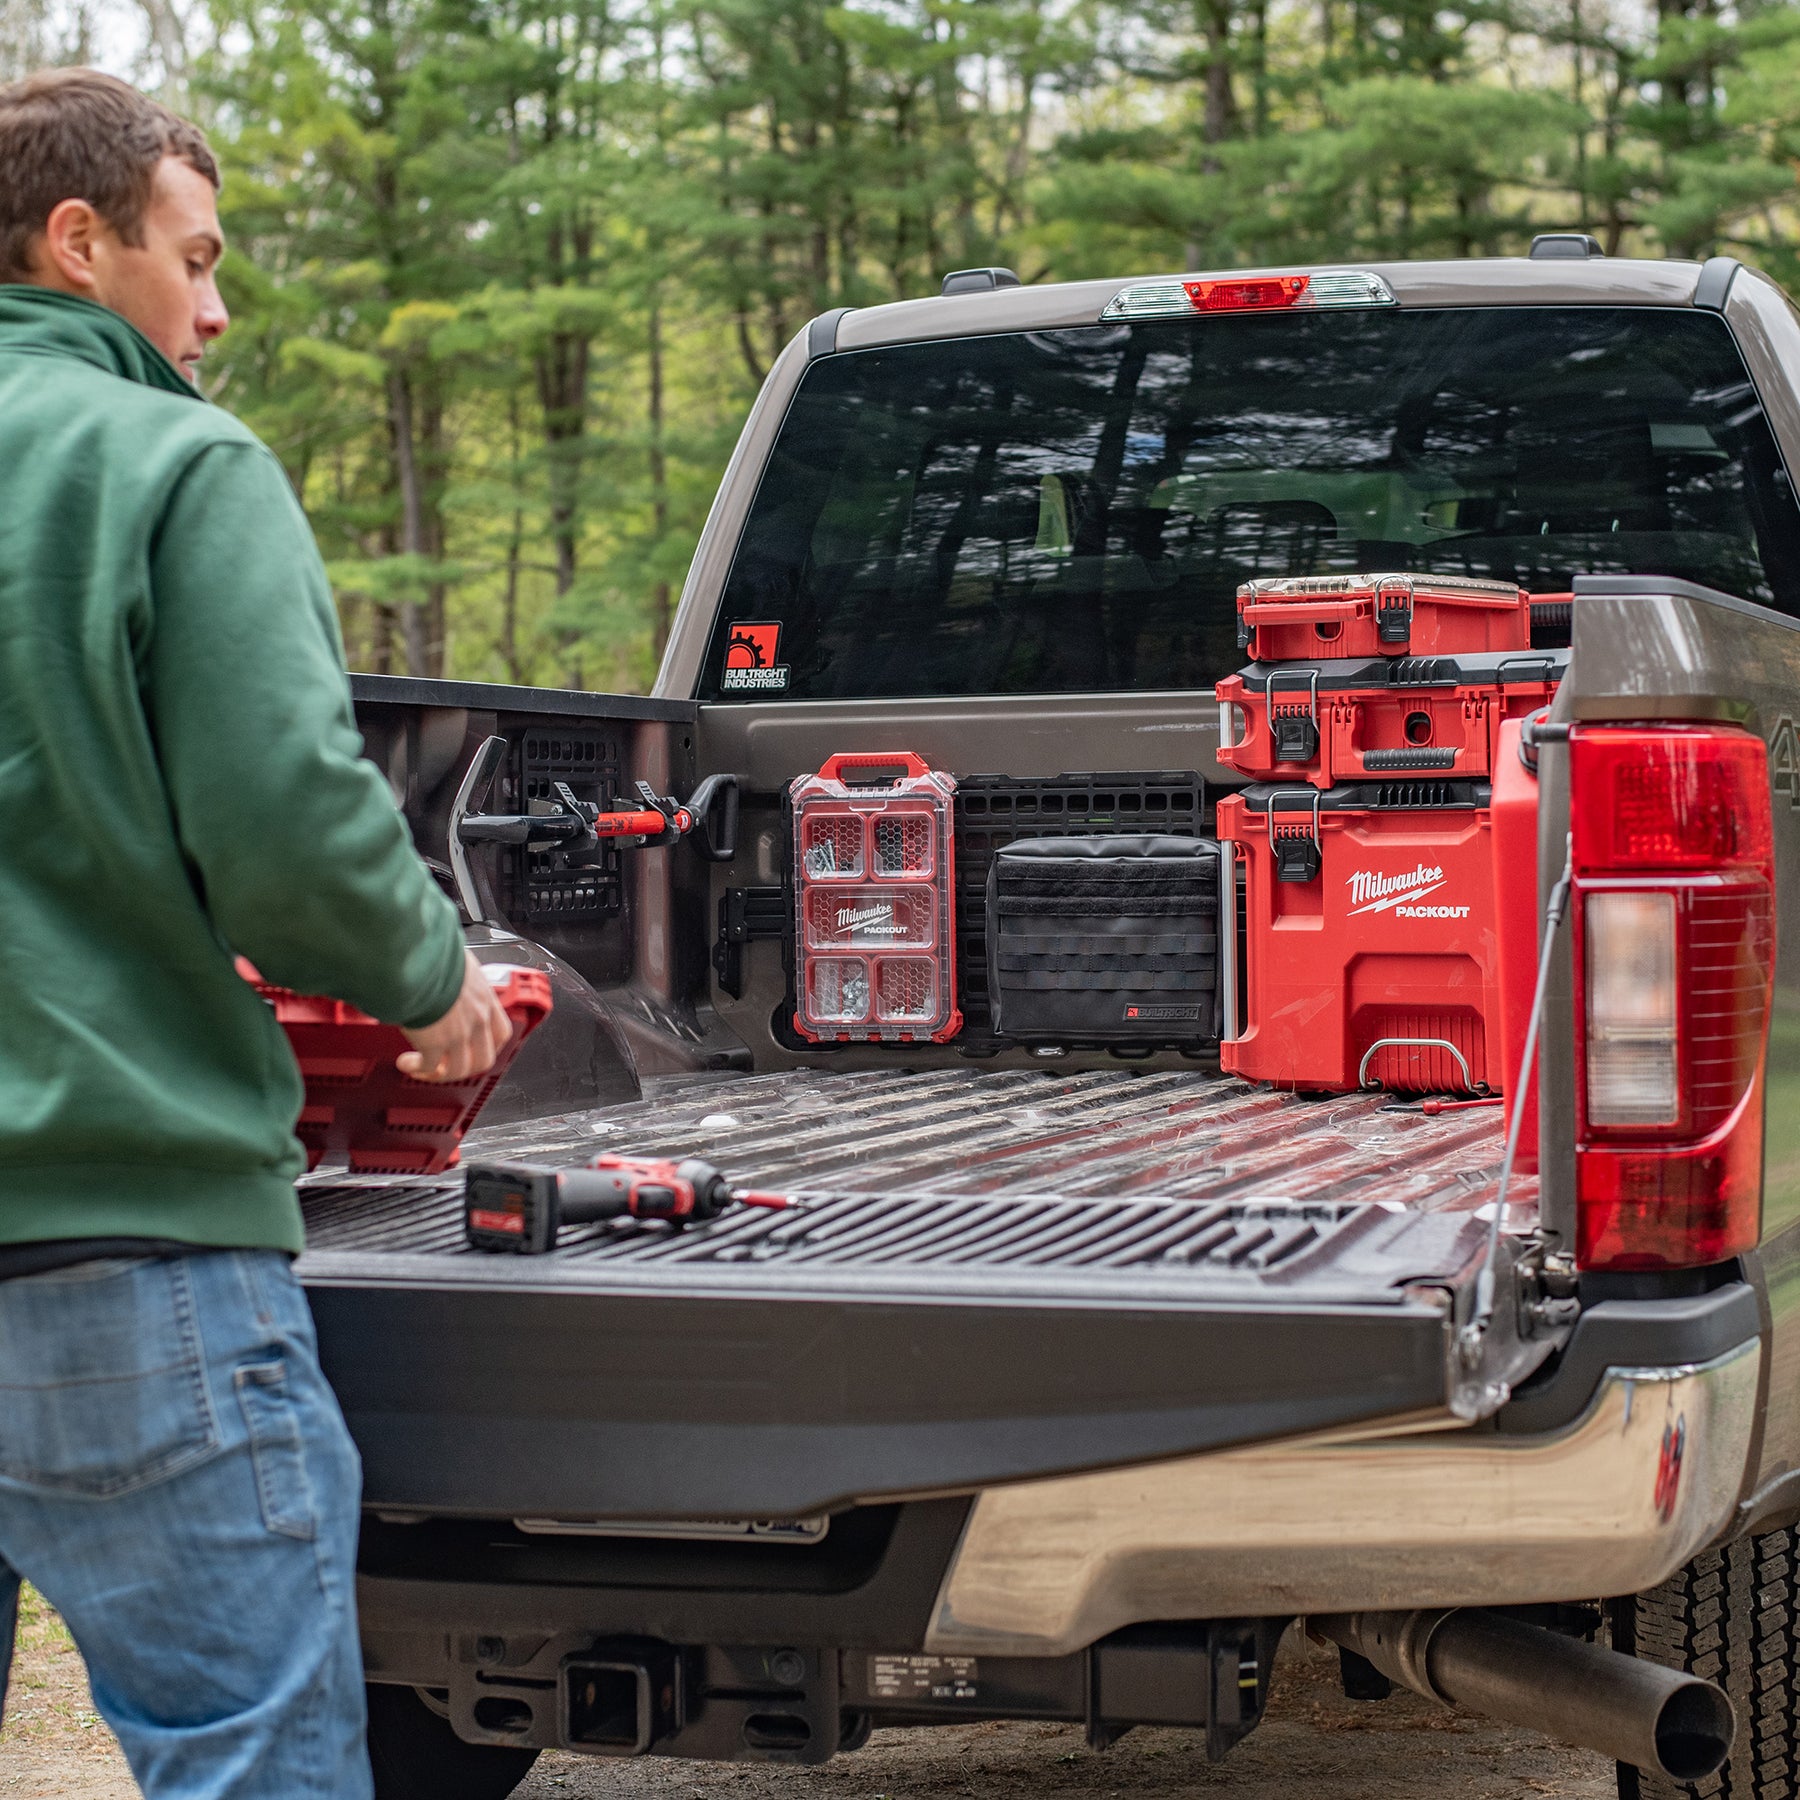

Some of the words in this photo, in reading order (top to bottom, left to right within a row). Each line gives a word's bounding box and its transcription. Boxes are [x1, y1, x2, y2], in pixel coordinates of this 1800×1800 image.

[726, 668, 787, 678] BUILTRIGHT
[724, 679, 785, 688] INDUSTRIES
[1768, 712, 1800, 811] 4
[1345, 863, 1444, 905] Milwaukee
[834, 903, 893, 927] Milwaukee
[1395, 906, 1471, 918] PACKOUT
[863, 926, 908, 934] PACKOUT
[1138, 1007, 1196, 1017] BUILTRIGHT
